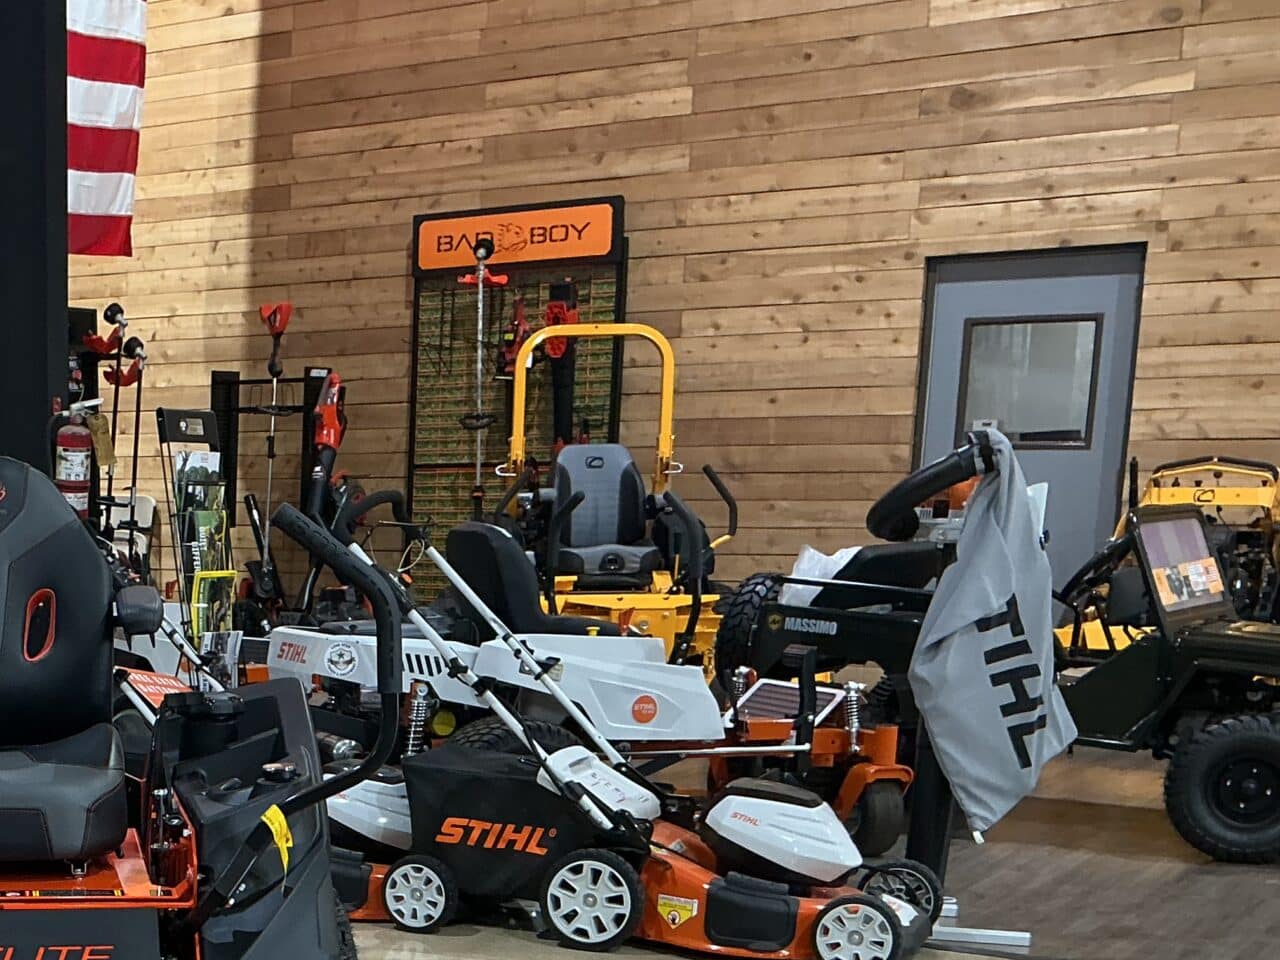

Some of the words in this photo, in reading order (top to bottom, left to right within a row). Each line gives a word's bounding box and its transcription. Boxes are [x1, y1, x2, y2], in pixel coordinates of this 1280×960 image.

[530, 222, 591, 244] BOY
[784, 616, 837, 635] MASSIMO
[277, 641, 308, 664] STIHL
[975, 593, 1047, 769] TIHL
[729, 811, 761, 826] STIHL
[435, 816, 549, 855] STIHL
